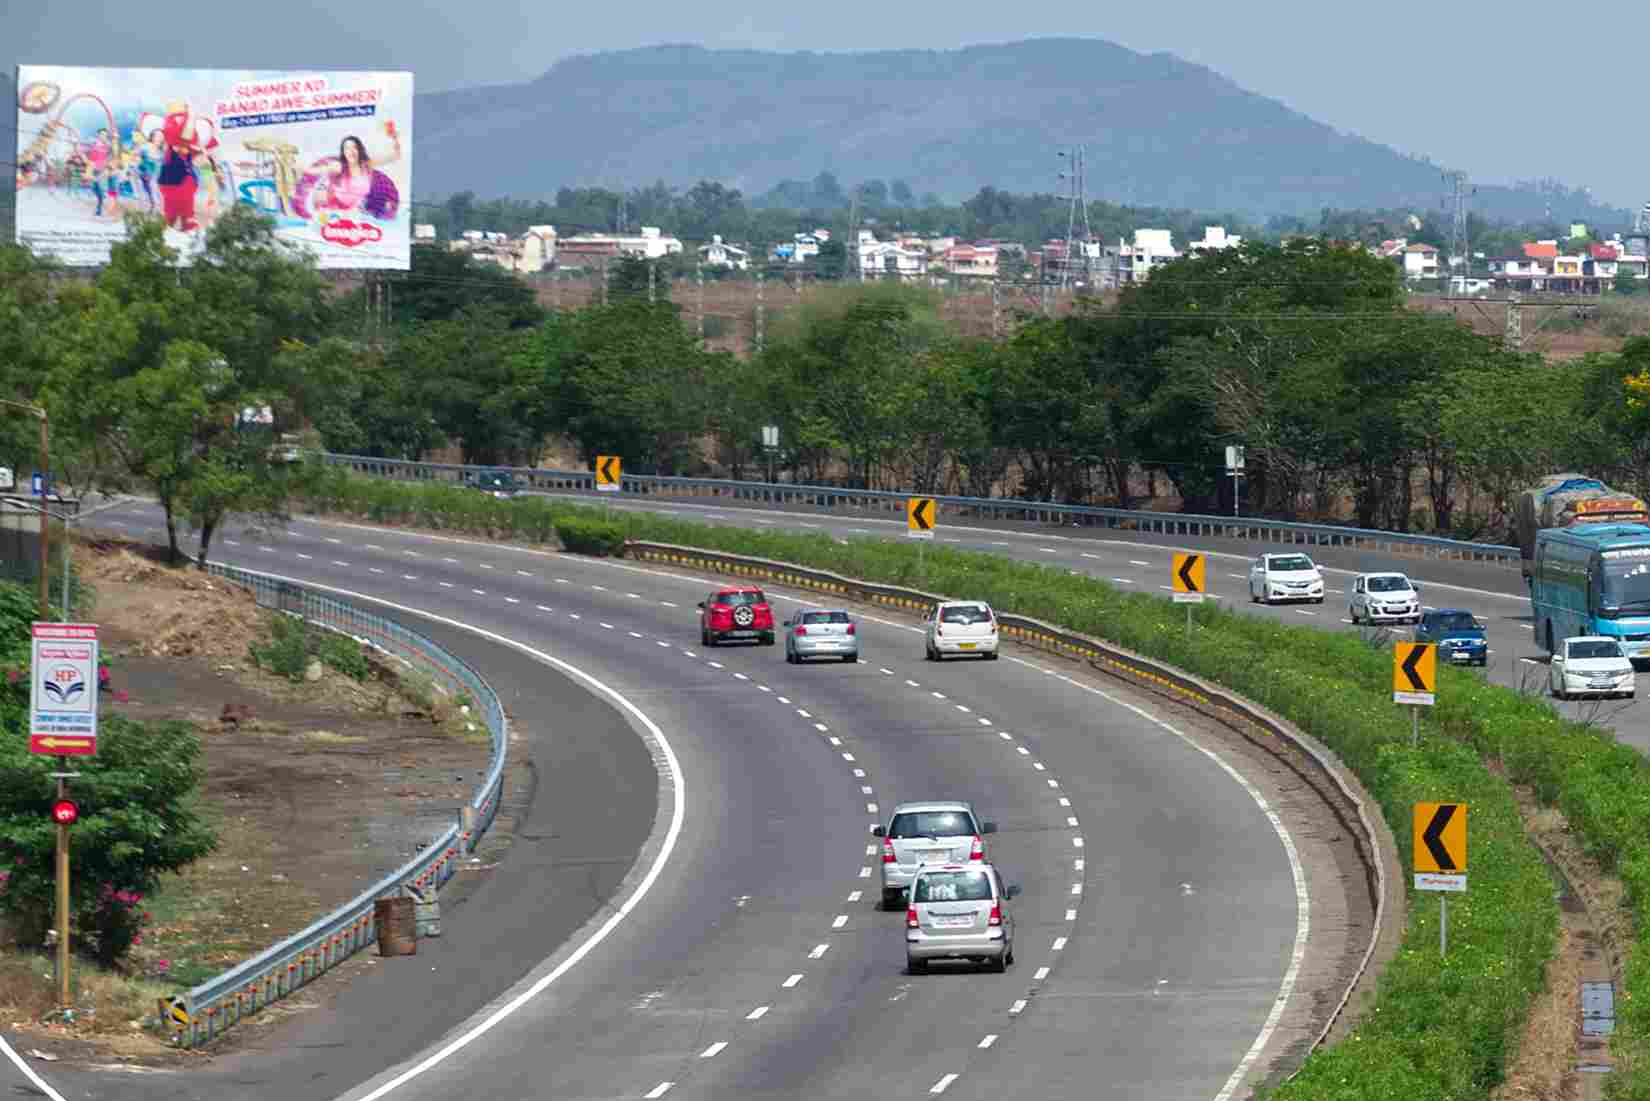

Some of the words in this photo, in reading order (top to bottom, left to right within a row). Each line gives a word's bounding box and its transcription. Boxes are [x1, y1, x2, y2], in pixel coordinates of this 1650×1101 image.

[237, 82, 300, 97] SUMMER
[216, 99, 269, 115] BANAO
[56, 671, 76, 681] HP
